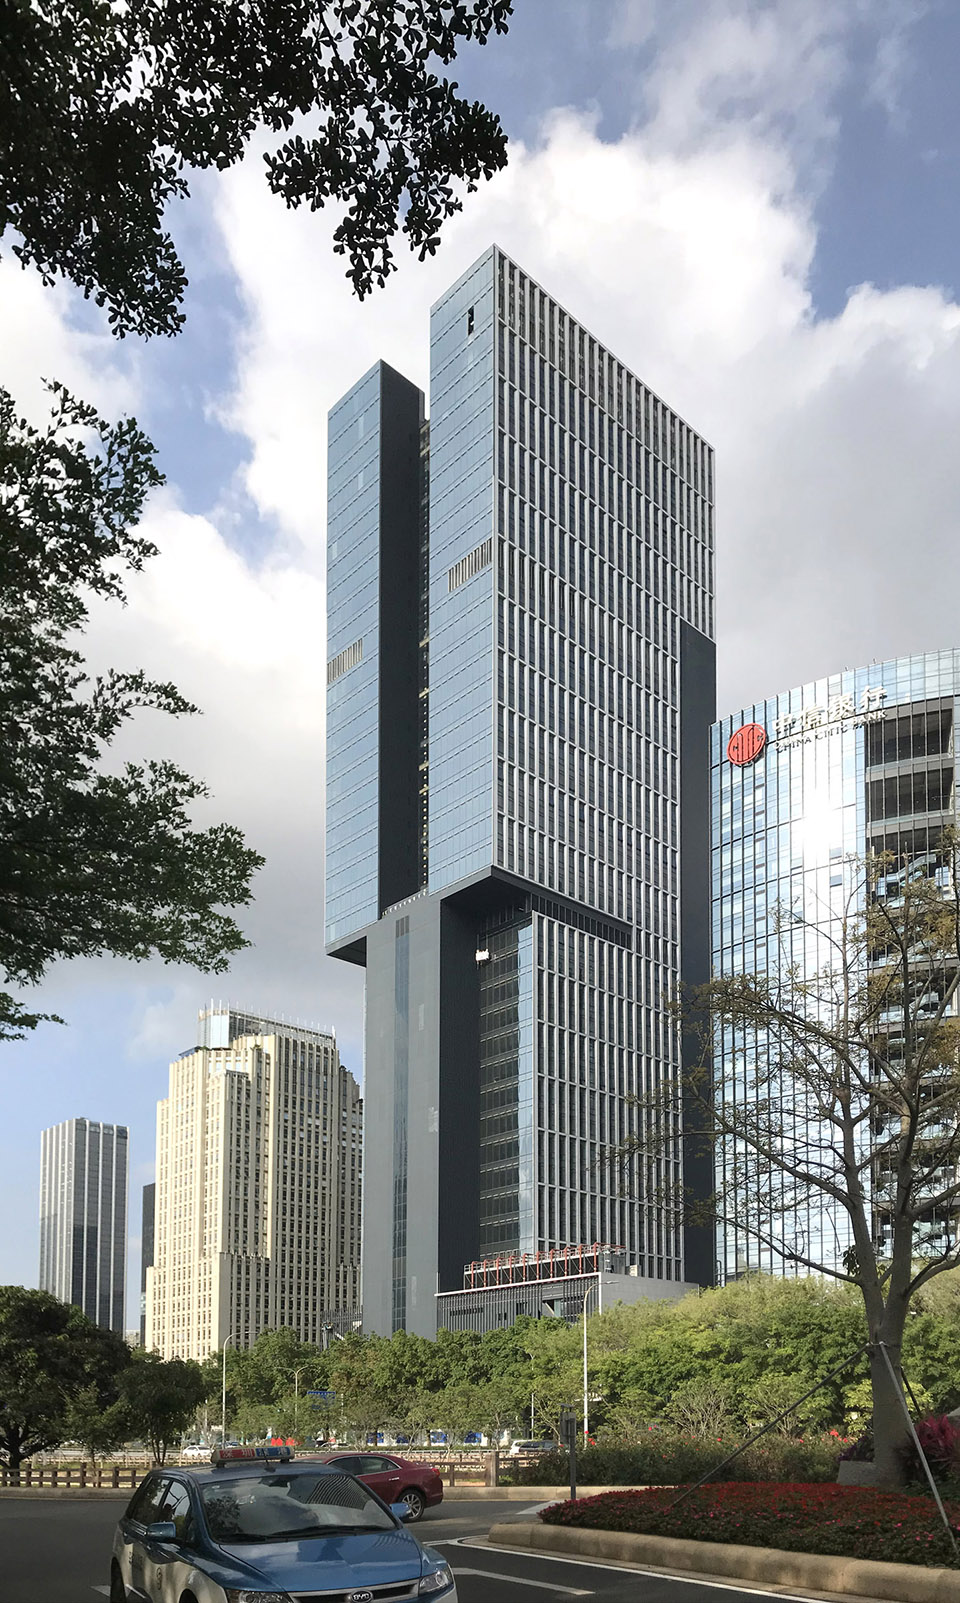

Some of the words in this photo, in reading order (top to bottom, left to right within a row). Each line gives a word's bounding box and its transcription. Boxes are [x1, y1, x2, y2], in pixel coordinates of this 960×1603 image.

[772, 685, 887, 735] 中信银行
[774, 736, 812, 753] CHINA
[814, 723, 848, 740] CITIC
[852, 710, 887, 729] BANK
